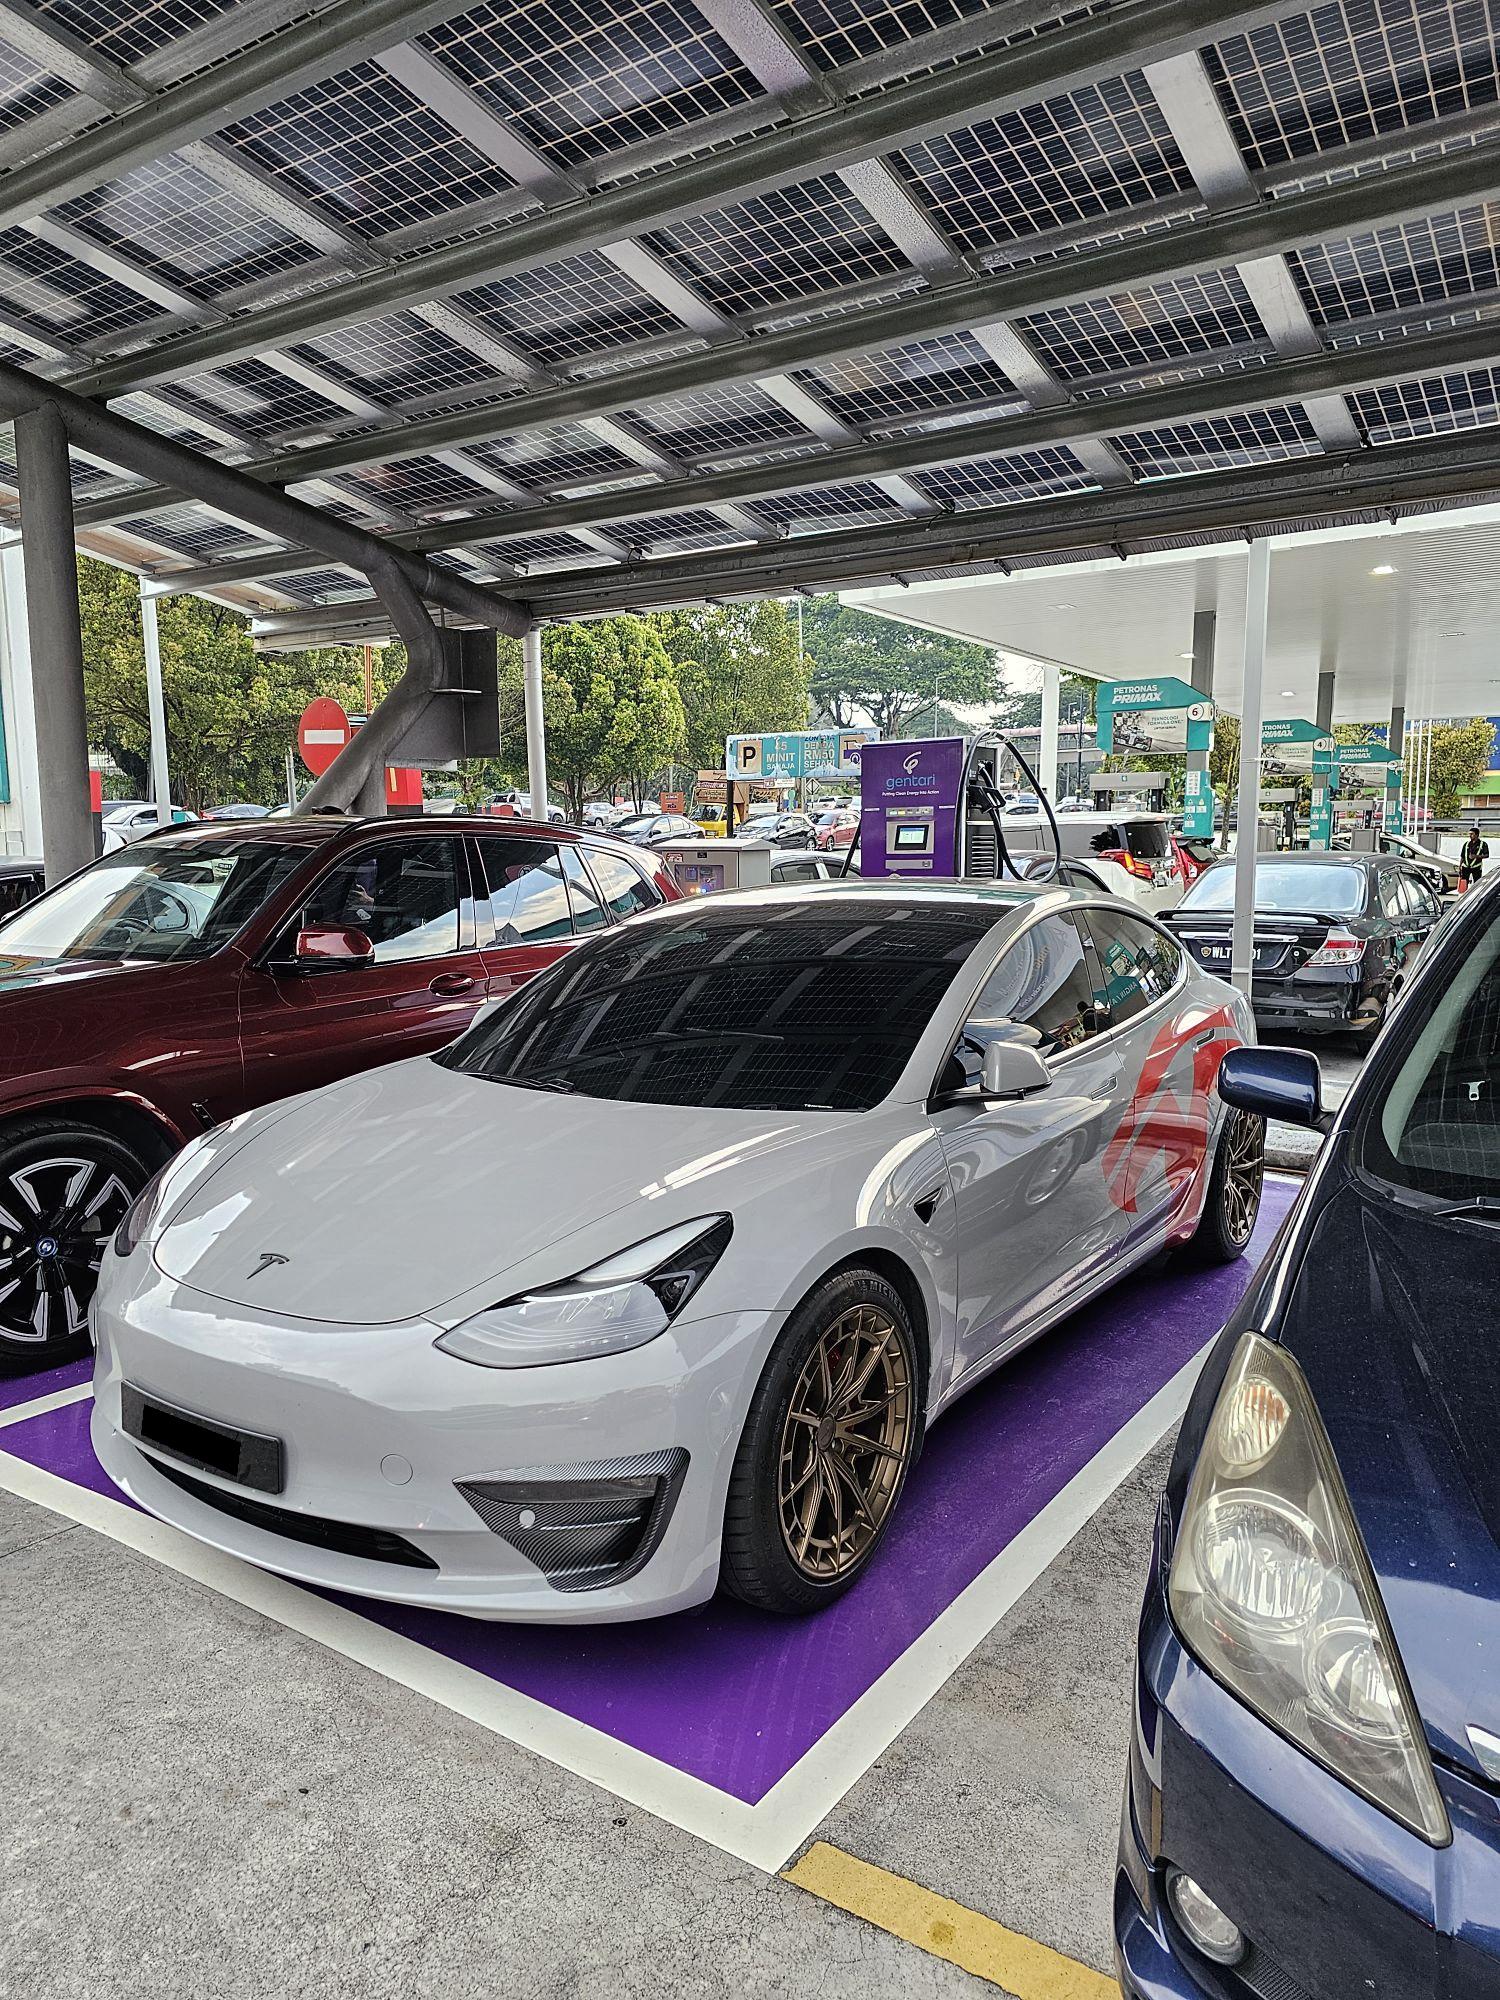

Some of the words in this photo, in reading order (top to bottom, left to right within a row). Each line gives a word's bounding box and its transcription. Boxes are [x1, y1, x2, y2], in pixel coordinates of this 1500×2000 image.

[1113, 684, 1158, 695] PETRONAS
[1112, 691, 1163, 704] PRIMAX
[1192, 708, 1198, 717] 6
[1262, 729, 1296, 738] RIMAX
[804, 740, 835, 750] DENDA
[743, 746, 756, 767] P
[766, 752, 795, 763] MINIT
[804, 749, 835, 760] RM50
[1339, 752, 1373, 760] PRIMAX
[886, 774, 935, 790] gentari
